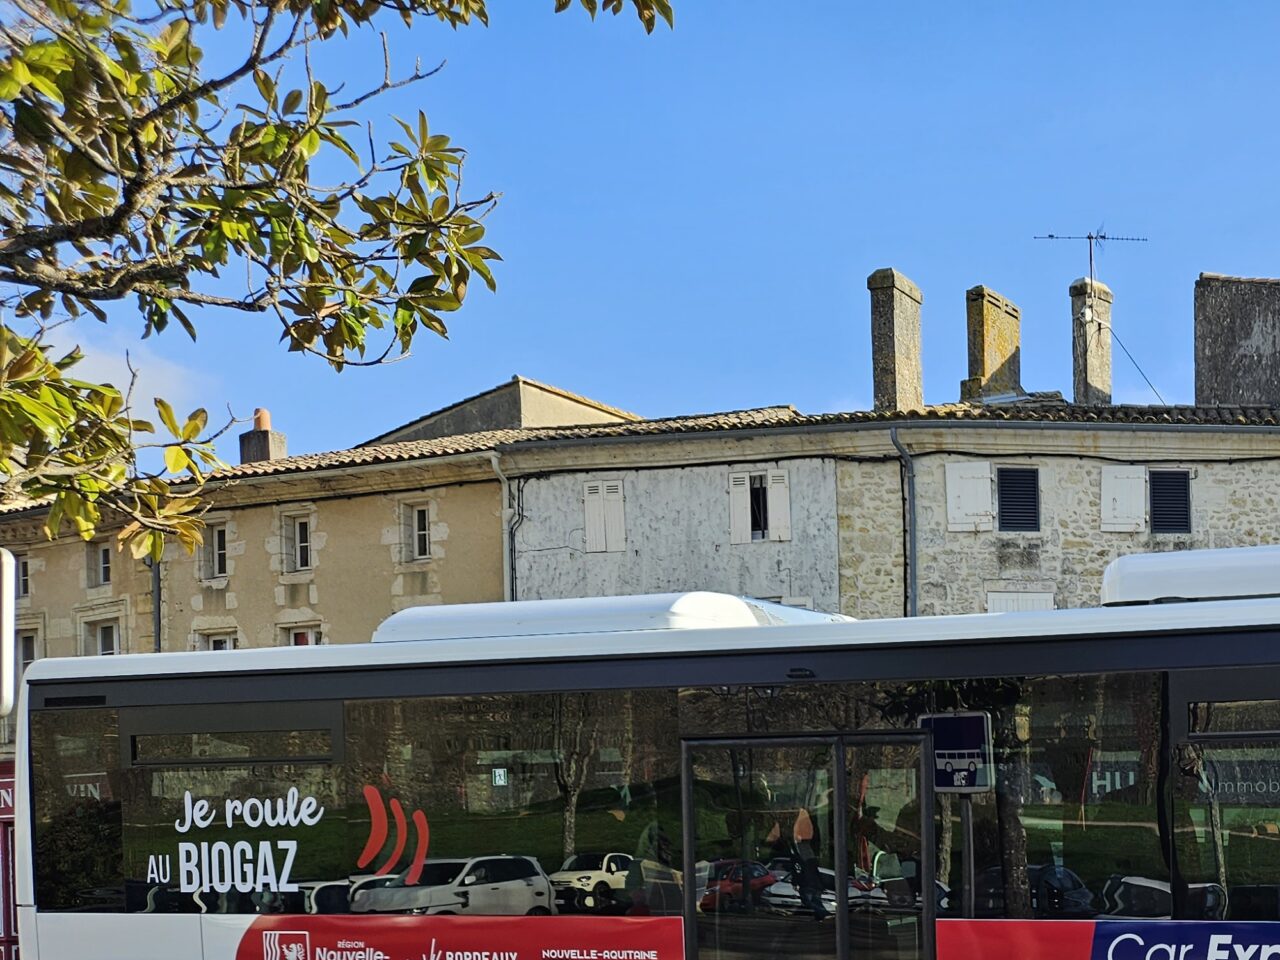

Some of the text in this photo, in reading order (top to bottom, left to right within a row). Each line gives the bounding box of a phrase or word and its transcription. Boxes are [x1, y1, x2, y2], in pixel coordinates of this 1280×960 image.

[174, 786, 325, 833] Je roule
[146, 840, 299, 893] AU BIOGAZ
[337, 939, 365, 949] RÉGION
[542, 949, 658, 960] NOUVELLE-AQUITAINE
